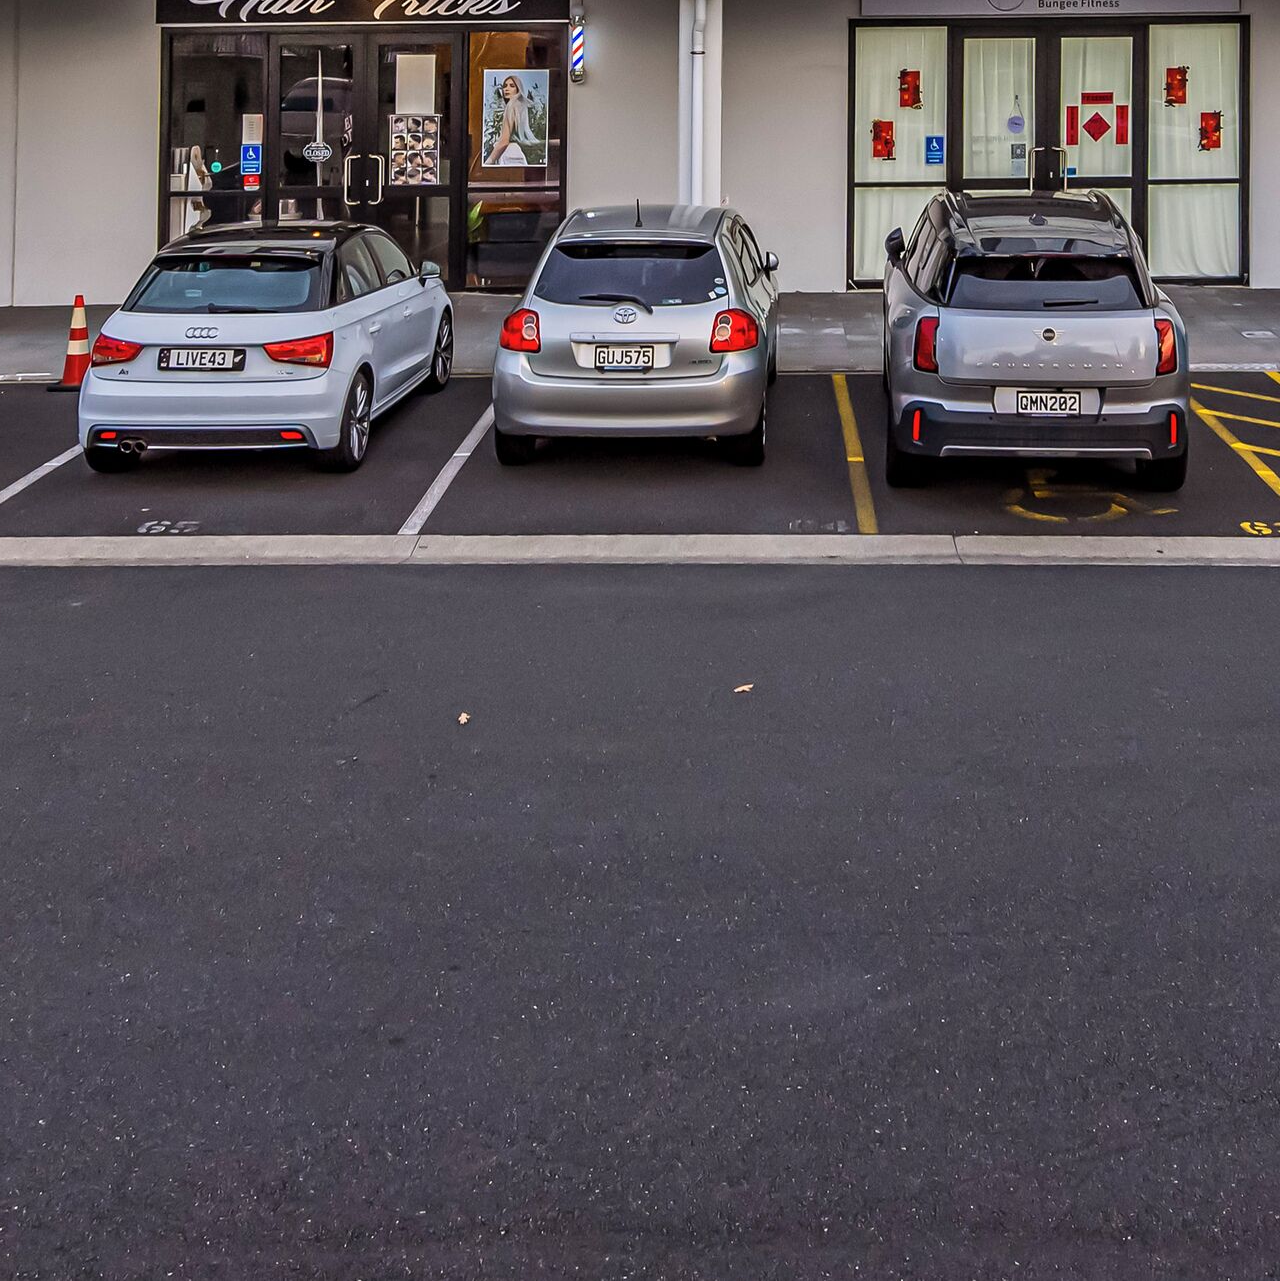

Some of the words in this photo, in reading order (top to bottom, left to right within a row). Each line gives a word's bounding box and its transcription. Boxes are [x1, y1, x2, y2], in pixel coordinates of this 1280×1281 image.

[1038, 0, 1078, 10] Bungee
[305, 149, 330, 157] CLOSED
[176, 351, 227, 367] LIVE43
[597, 349, 652, 365] GUJ575
[1019, 395, 1079, 413] QMN202
[136, 520, 201, 534] 65
